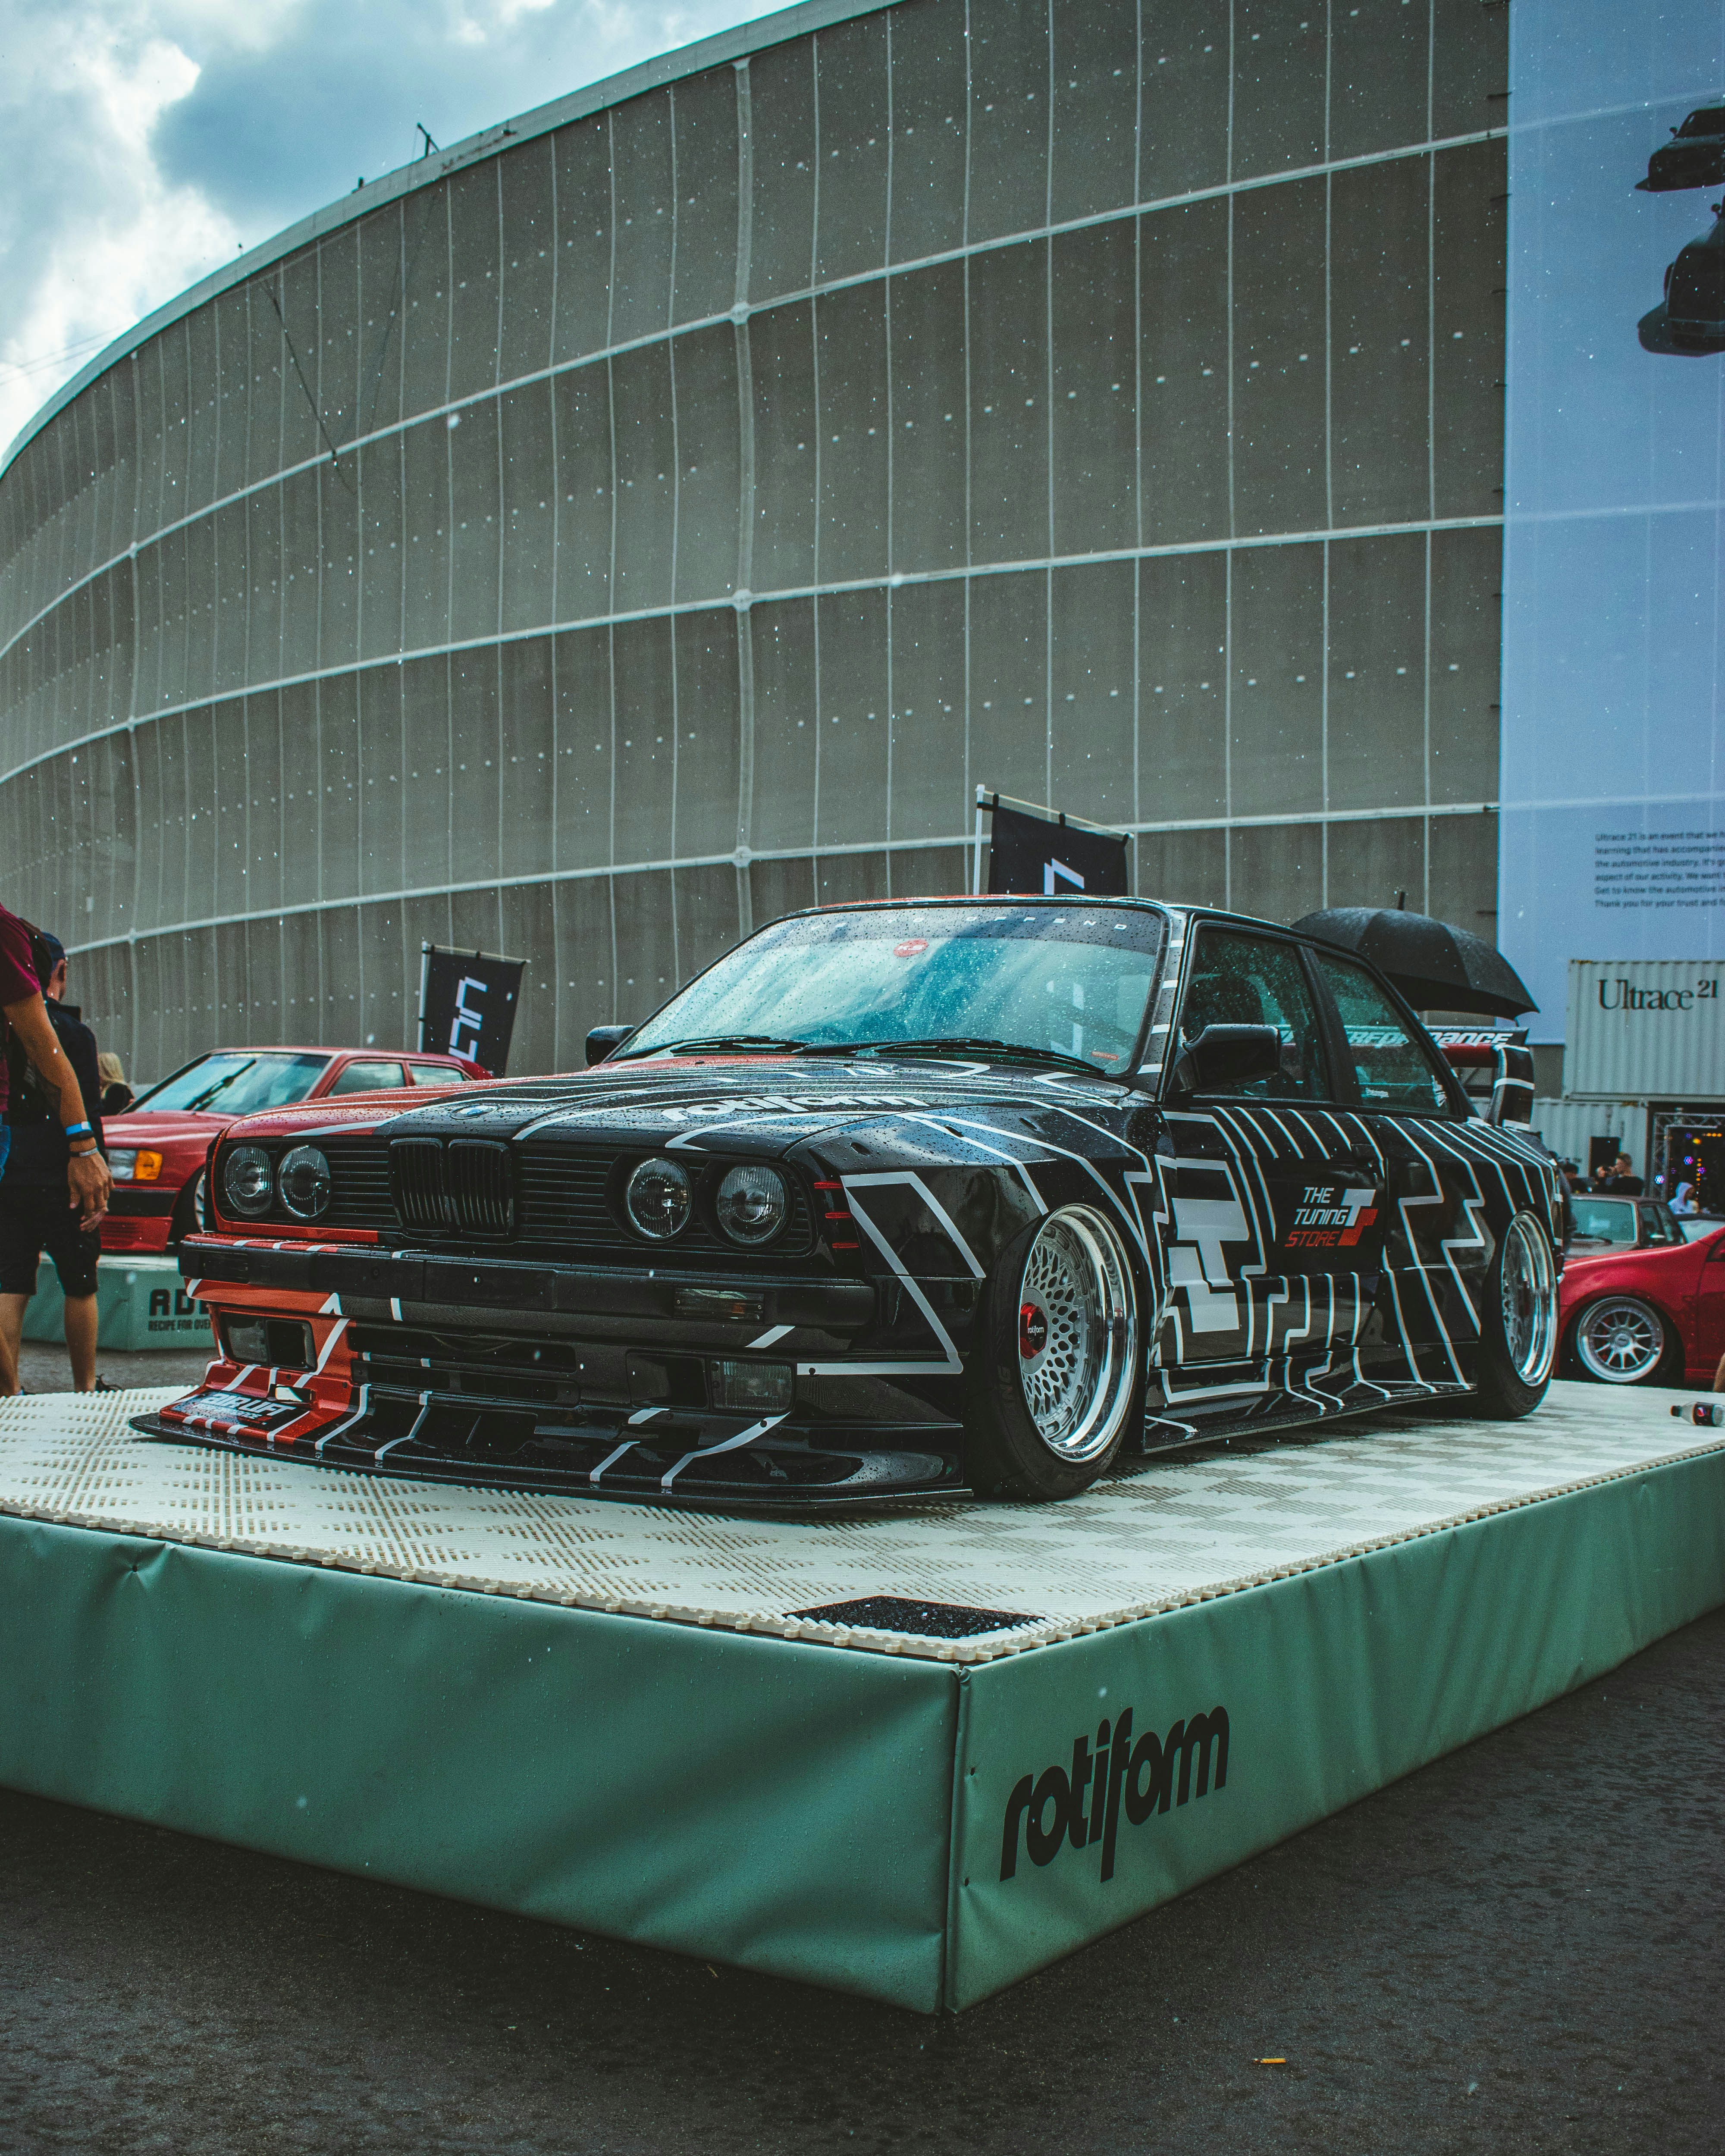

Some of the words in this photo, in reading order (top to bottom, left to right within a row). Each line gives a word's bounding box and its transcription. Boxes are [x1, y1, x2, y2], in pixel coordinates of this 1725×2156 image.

[965, 915, 1128, 931] OFFEND
[1597, 979, 1695, 1010] Ultrace
[1697, 979, 1719, 998] 21
[662, 1095, 930, 1122] rotiform
[1302, 1187, 1335, 1203] THE
[1293, 1208, 1349, 1225] TUNING
[1284, 1231, 1340, 1247] STORE
[148, 1320, 176, 1332] RECIPE
[177, 1319, 192, 1330] FOR
[1027, 1325, 1044, 1336] rotiform
[1000, 1705, 1230, 1883] rotiform
